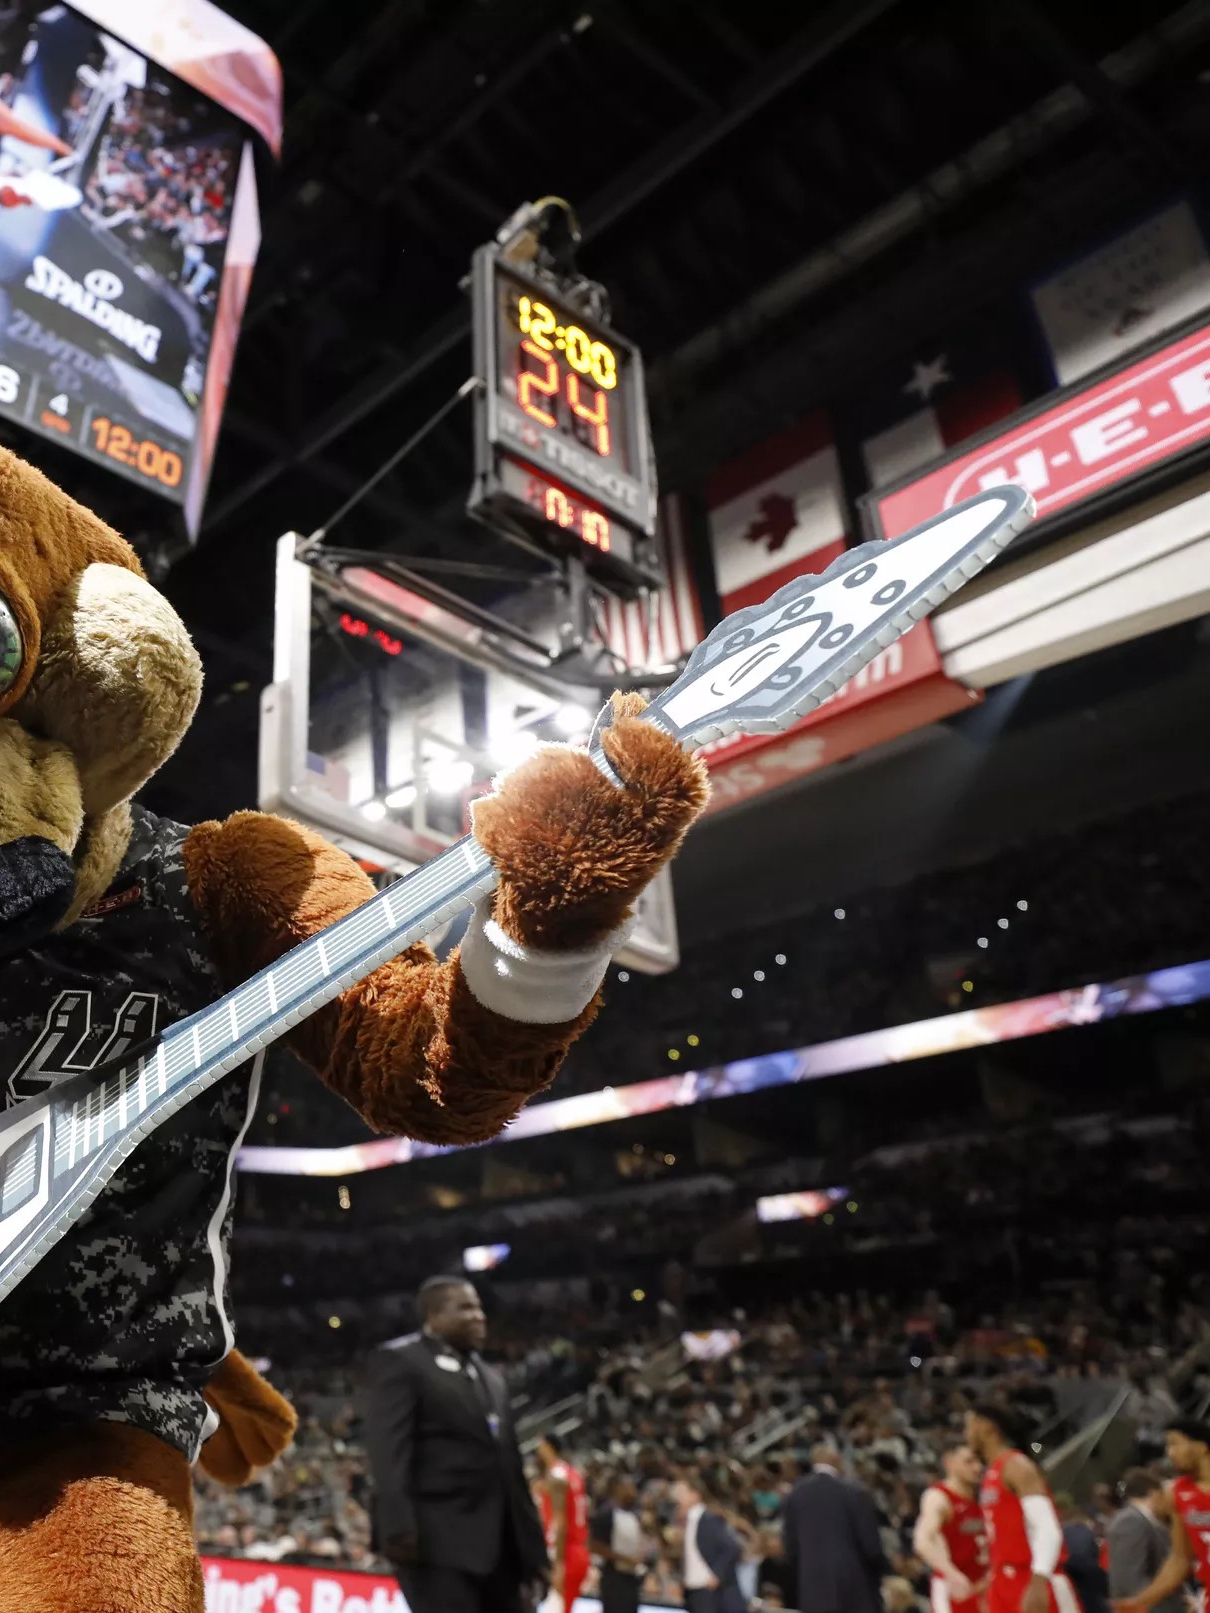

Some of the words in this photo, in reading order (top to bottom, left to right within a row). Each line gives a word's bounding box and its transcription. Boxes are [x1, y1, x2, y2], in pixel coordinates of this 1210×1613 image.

[25, 255, 162, 364] SPALDING
[519, 296, 617, 390] 12:00
[517, 338, 611, 457] 24
[93, 417, 182, 487] 12:00
